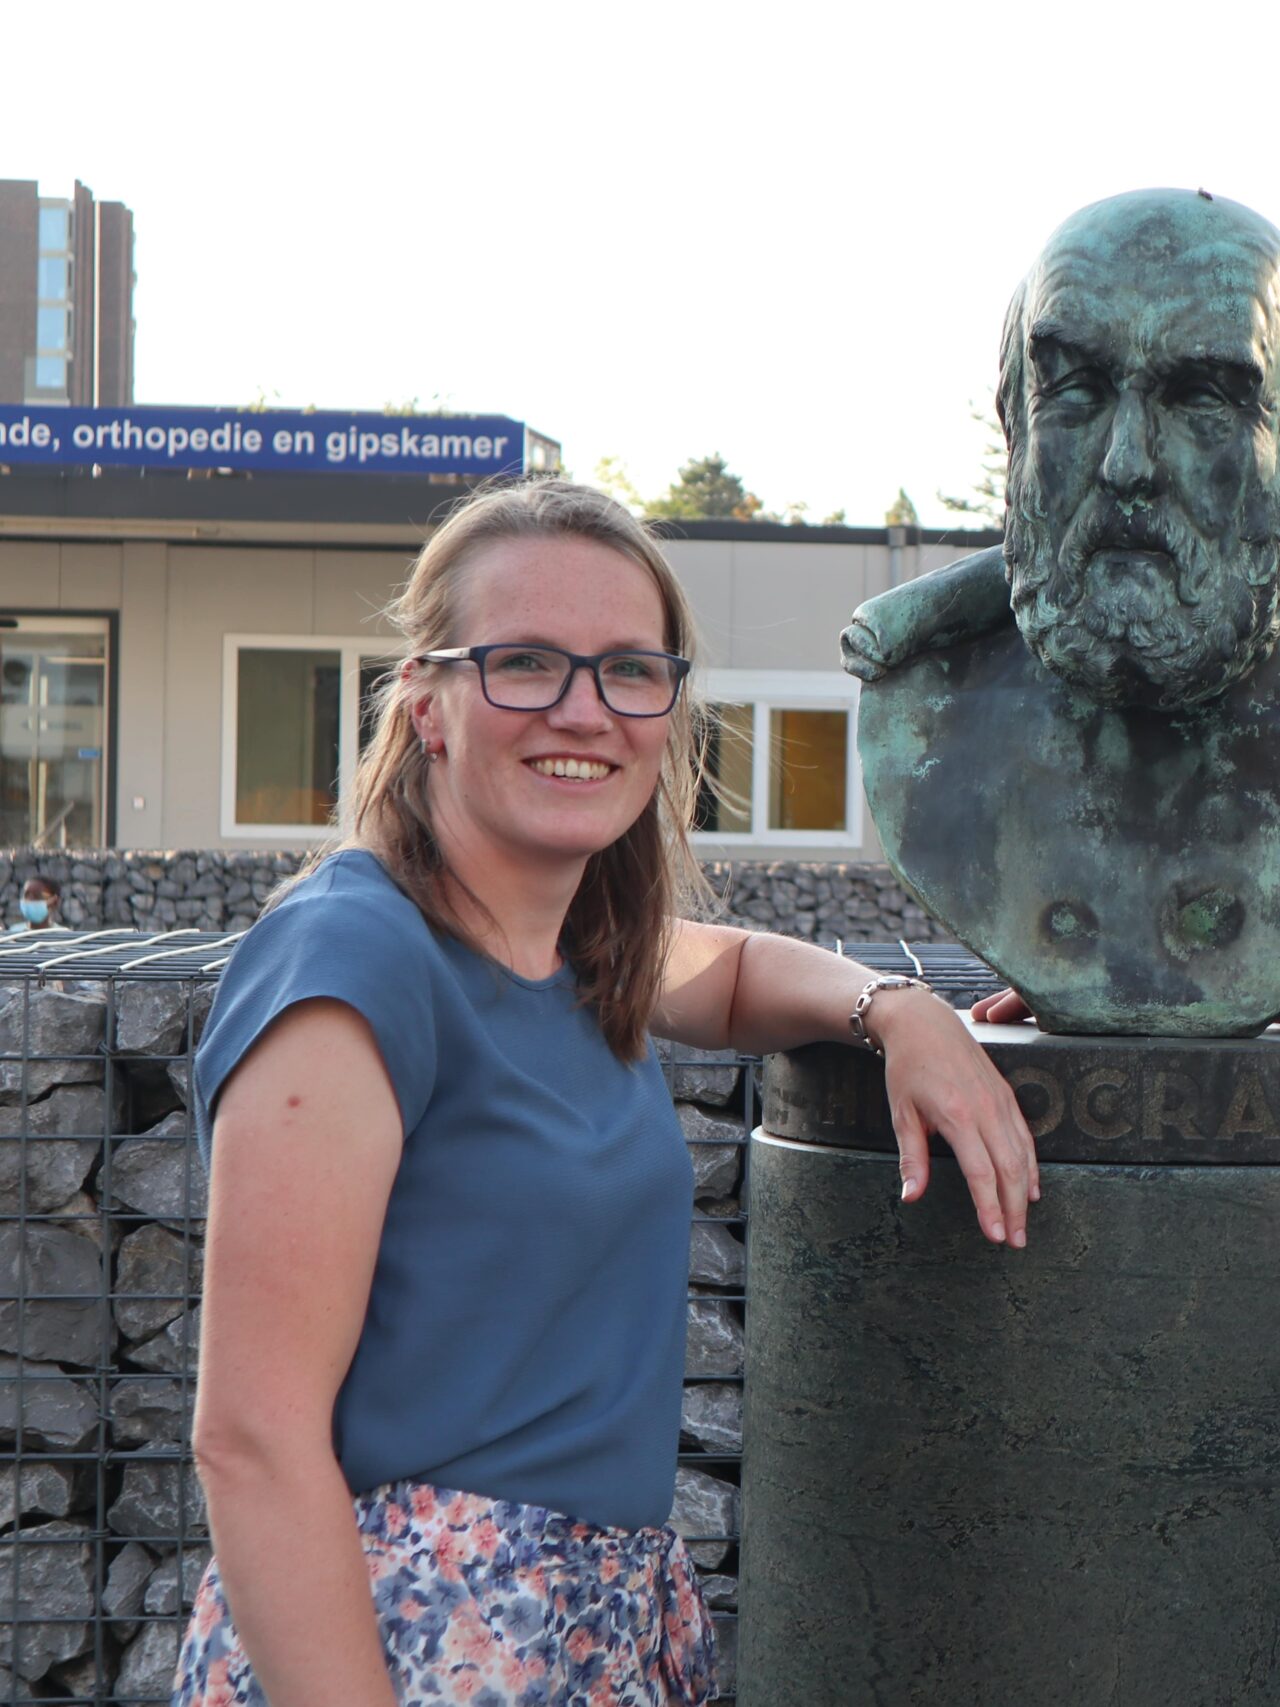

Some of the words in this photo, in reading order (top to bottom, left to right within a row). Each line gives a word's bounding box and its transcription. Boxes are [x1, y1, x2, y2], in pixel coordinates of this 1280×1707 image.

[73, 420, 262, 456] orthopedie
[273, 430, 315, 454] en
[326, 426, 509, 463] gipskamer
